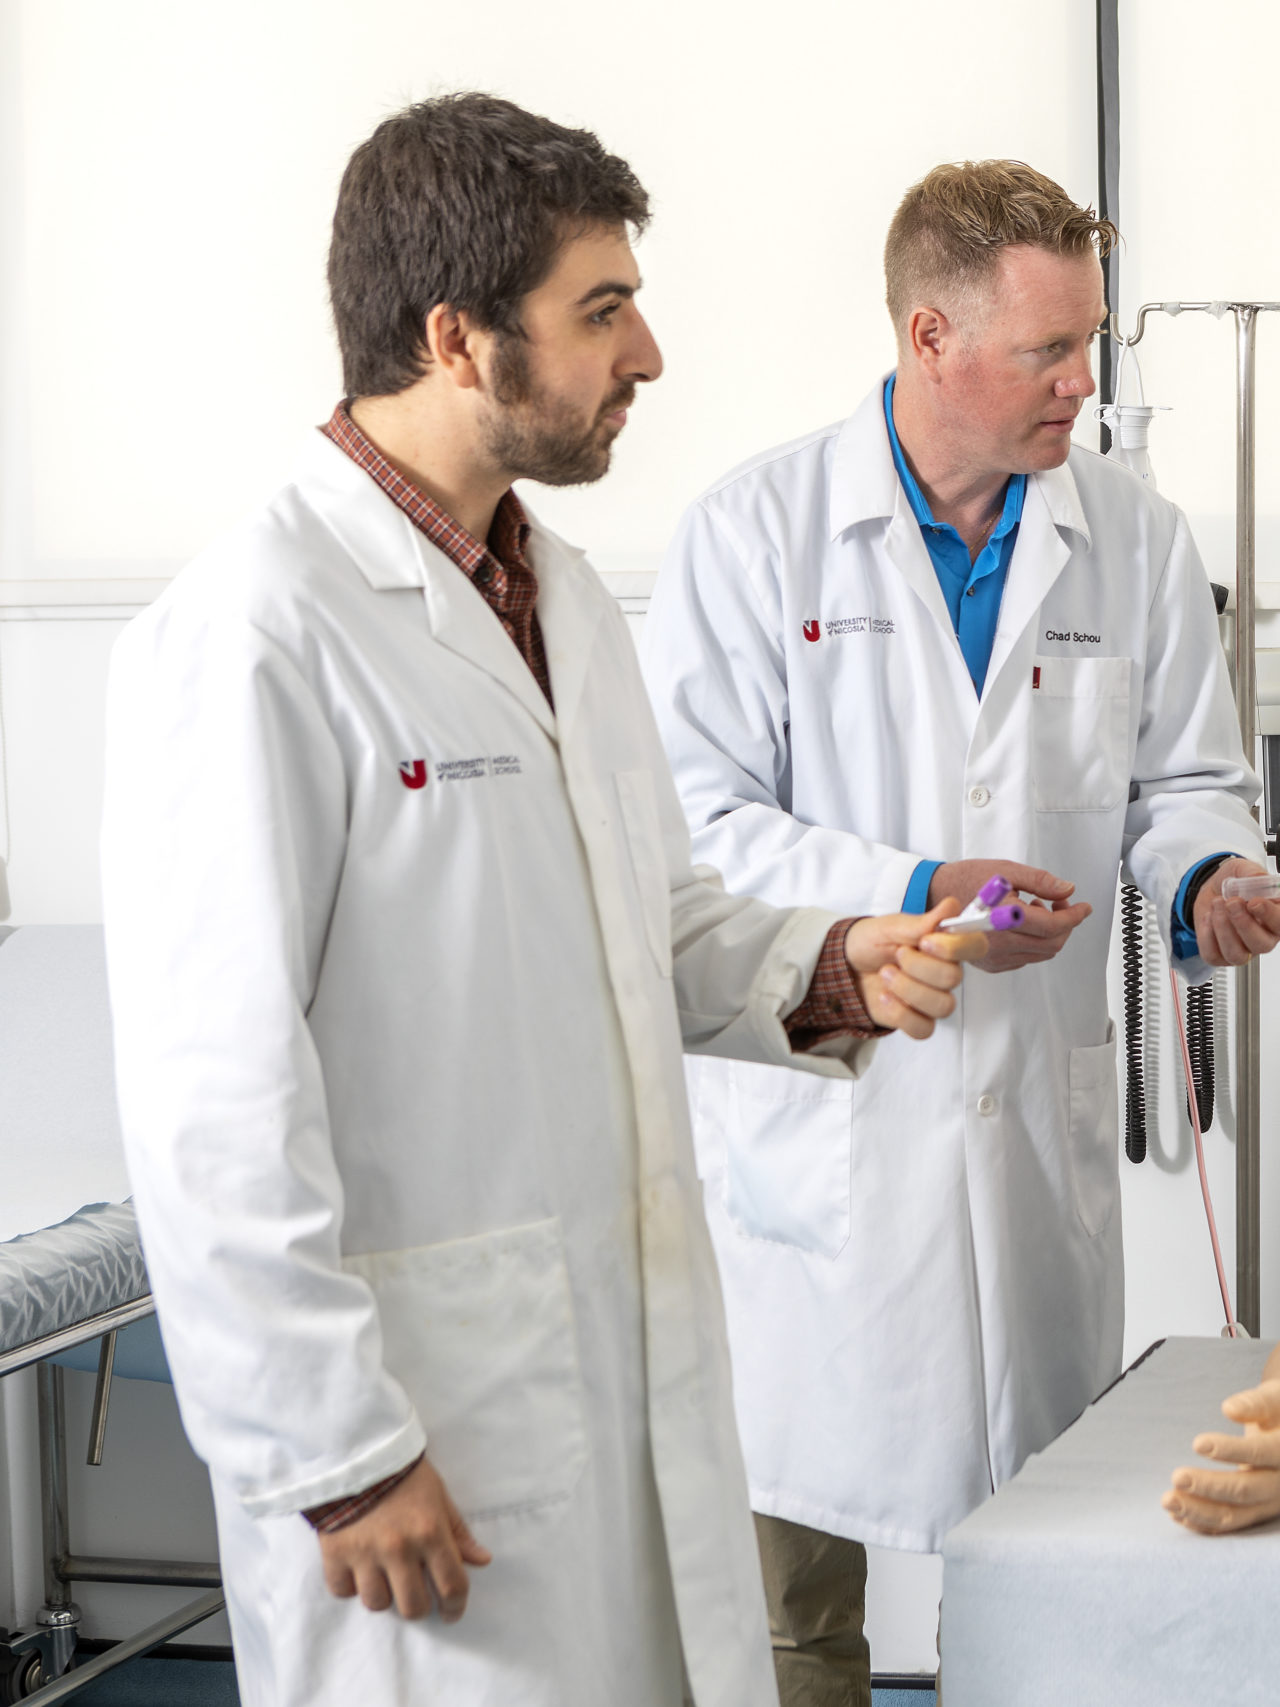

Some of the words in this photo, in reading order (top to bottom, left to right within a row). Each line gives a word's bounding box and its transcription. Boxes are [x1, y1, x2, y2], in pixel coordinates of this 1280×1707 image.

[825, 617, 867, 629] UNIVERSITY
[834, 625, 865, 635] NICOSIA
[1045, 630, 1070, 641] Chad
[1073, 632, 1101, 643] Schou
